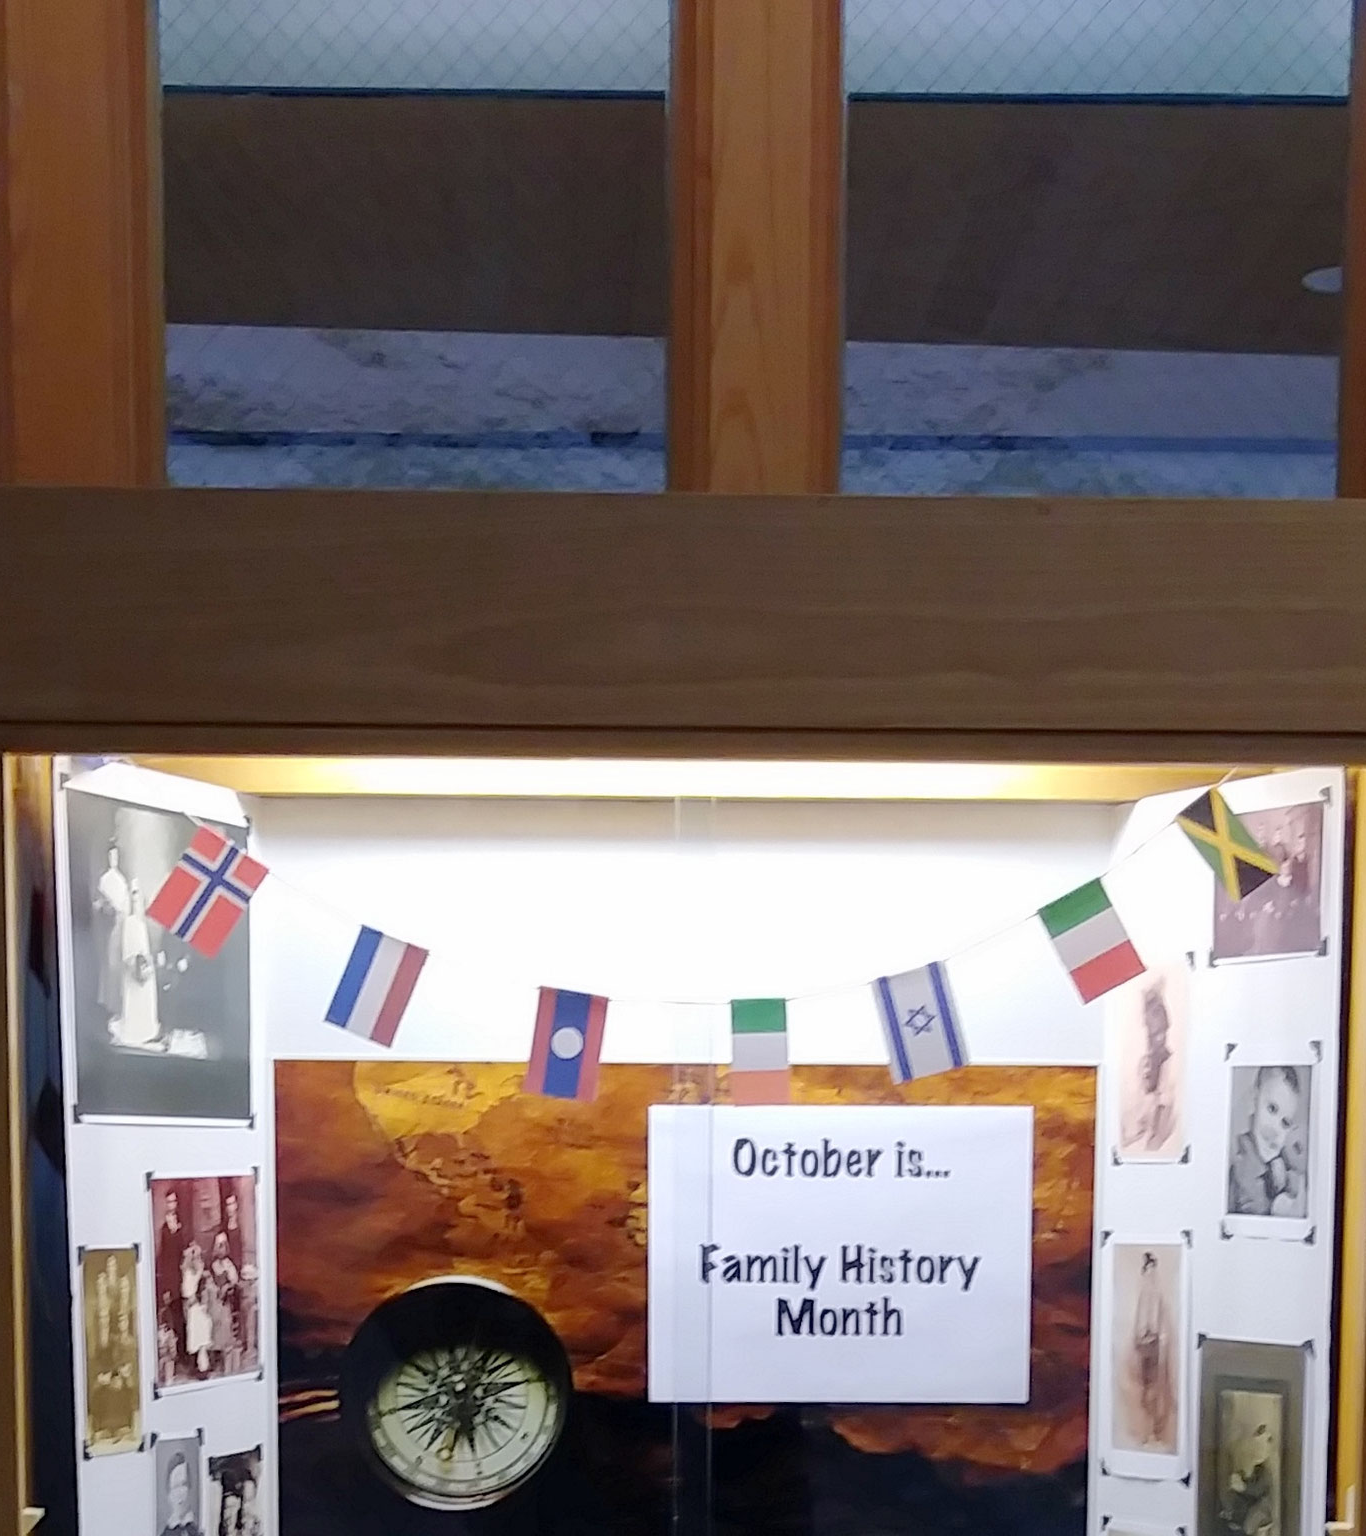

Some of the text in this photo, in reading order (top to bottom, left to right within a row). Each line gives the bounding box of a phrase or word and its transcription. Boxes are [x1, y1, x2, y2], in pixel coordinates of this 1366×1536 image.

[733, 1137, 951, 1179] October is...
[700, 1244, 982, 1291] Family History
[776, 1296, 903, 1337] Month
